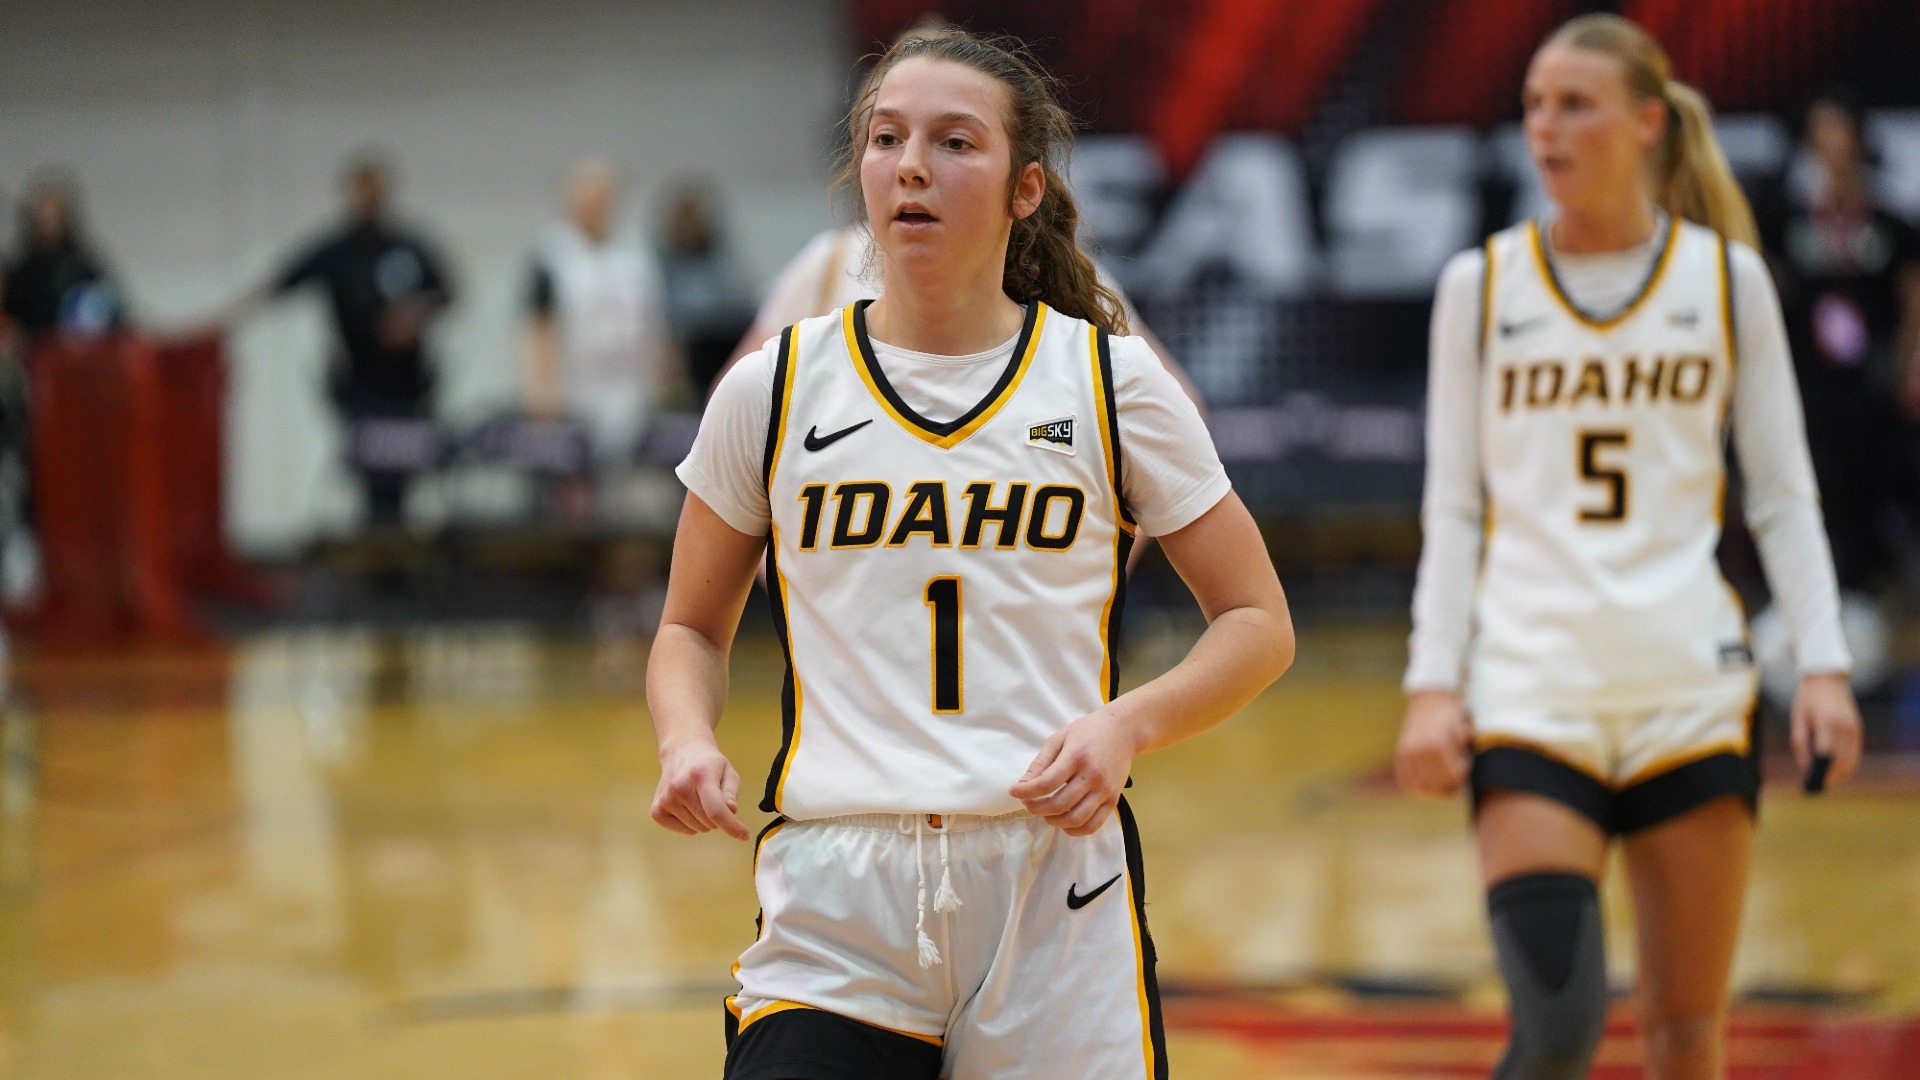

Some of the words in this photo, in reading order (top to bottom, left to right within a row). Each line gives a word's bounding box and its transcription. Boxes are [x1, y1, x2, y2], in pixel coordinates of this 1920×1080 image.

[1499, 354, 1714, 414] IDAHO
[797, 481, 1086, 552] IDAHO
[1575, 427, 1632, 525] 5
[924, 575, 964, 714] 1
